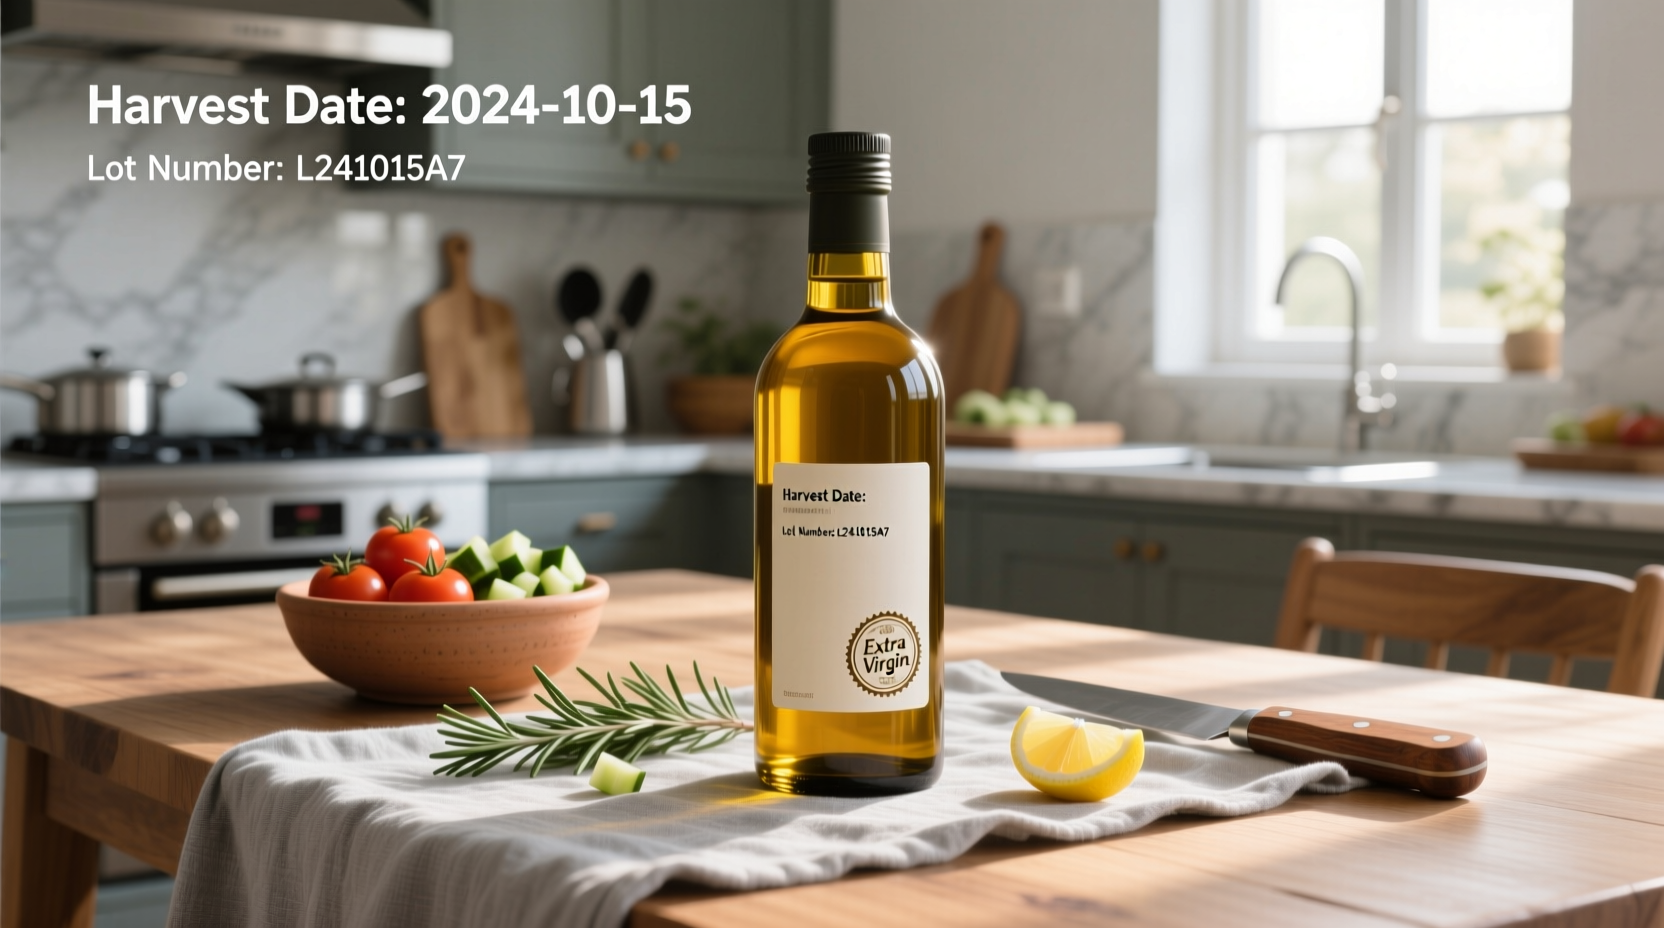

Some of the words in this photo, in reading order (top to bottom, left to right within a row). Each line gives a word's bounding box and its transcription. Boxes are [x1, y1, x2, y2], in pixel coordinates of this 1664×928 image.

[782, 488, 828, 502] Harvest
[832, 489, 866, 503] Date:
[863, 637, 906, 655] Extra
[863, 653, 910, 676] Virgin
